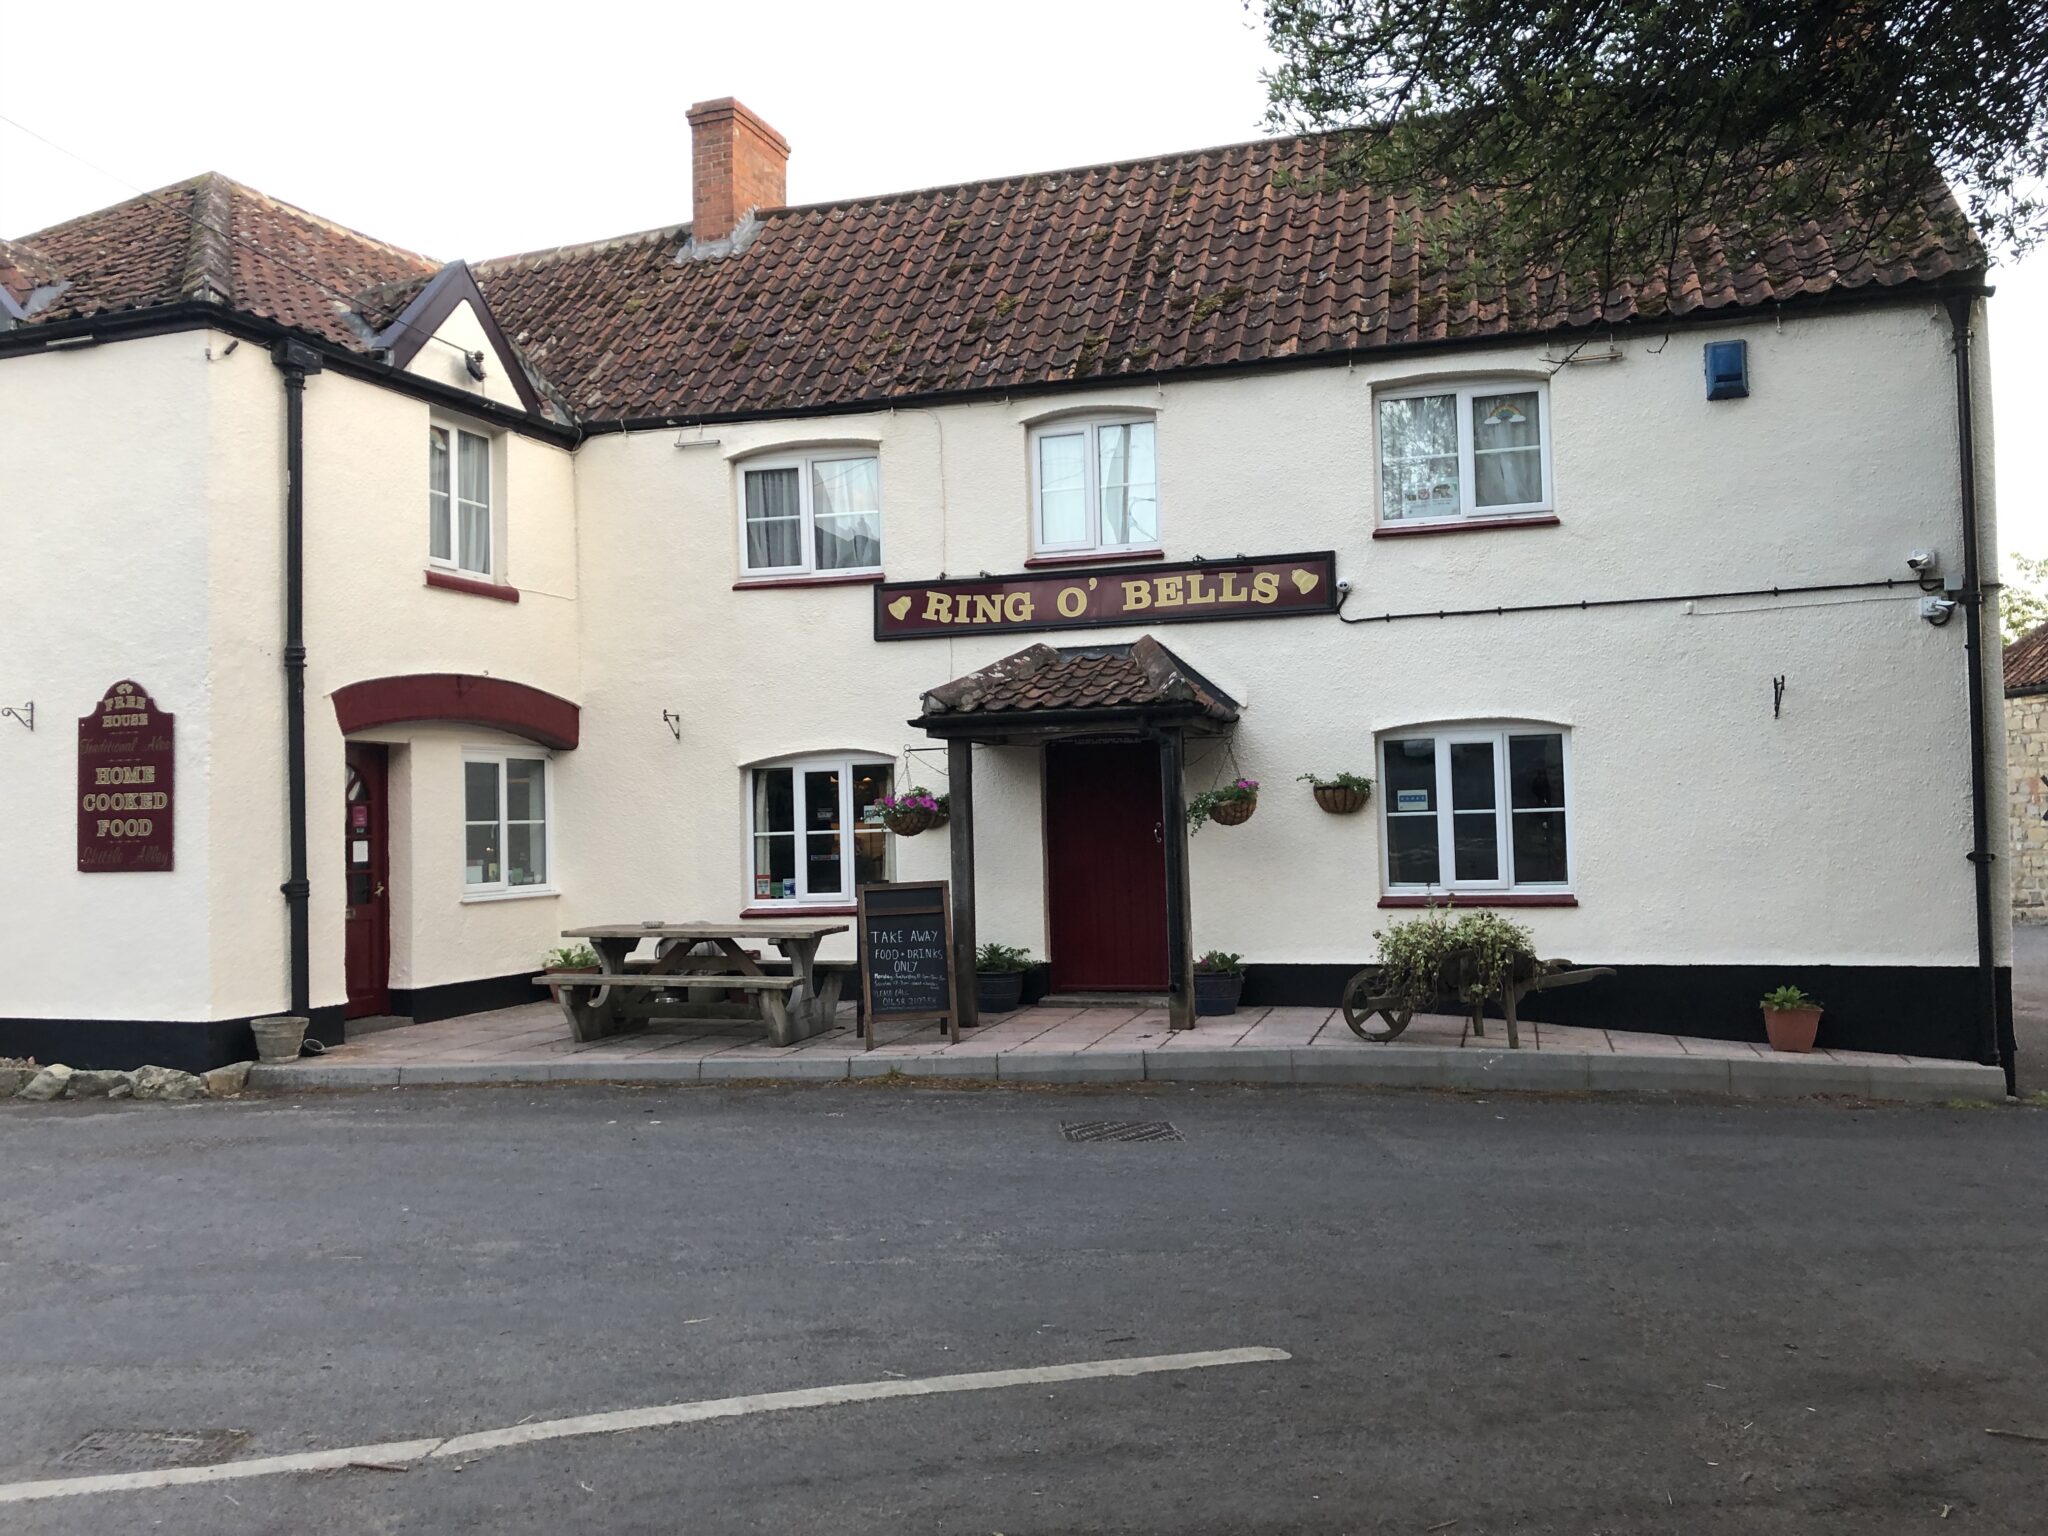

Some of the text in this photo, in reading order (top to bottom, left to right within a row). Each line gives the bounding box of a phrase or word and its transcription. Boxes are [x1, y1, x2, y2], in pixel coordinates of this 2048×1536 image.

[922, 572, 1280, 624] RING O' BELLS
[103, 696, 147, 712] FREE
[102, 713, 149, 727] HOUSE
[95, 766, 156, 785] HOME
[83, 792, 168, 812] COOKED
[97, 818, 153, 837] FOOD
[869, 929, 938, 944] TAKE AWAY
[875, 948, 899, 960] FOOD
[907, 948, 943, 960] DRINKS
[893, 960, 918, 973] ONLY
